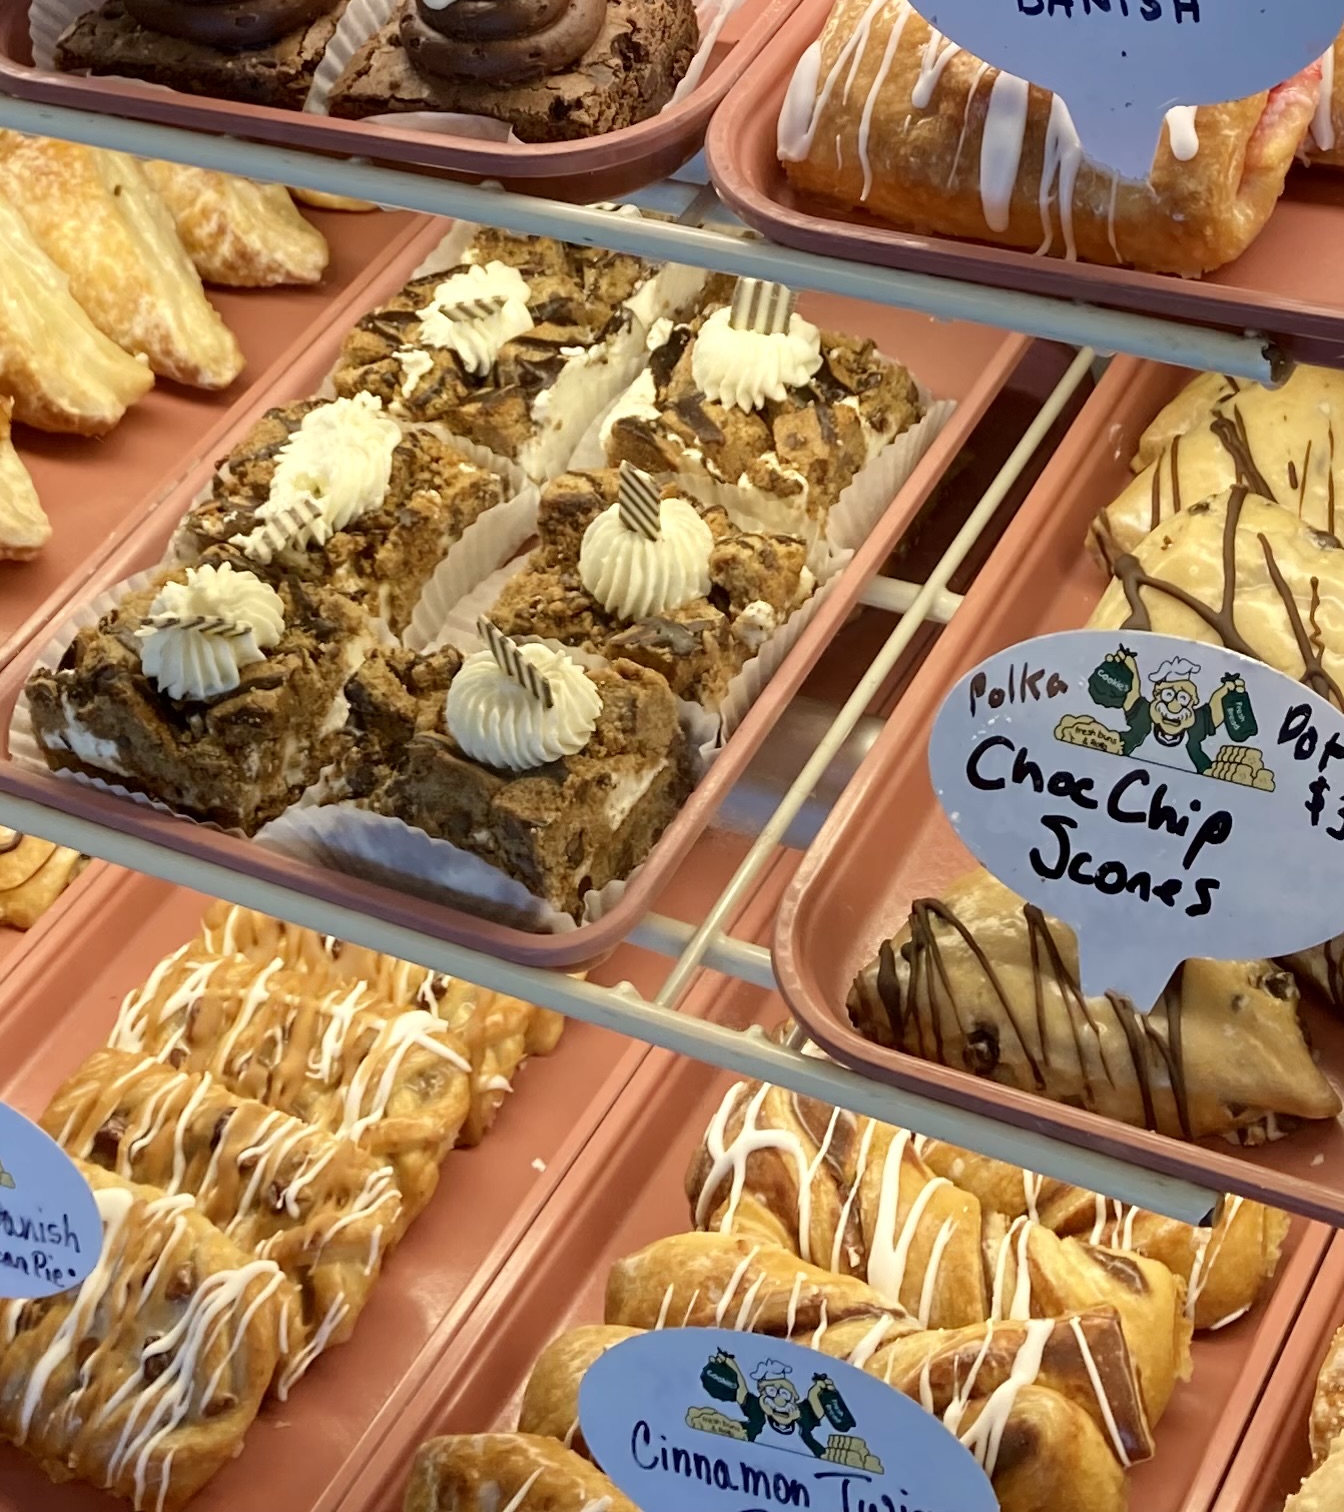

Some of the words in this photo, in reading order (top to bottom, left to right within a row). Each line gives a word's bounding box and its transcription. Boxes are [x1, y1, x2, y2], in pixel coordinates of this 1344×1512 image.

[969, 661, 1069, 718] Polka
[1028, 813, 1221, 918] Scones
[1106, 768, 1234, 870] Chip
[631, 1419, 811, 1509] Cinnamon
